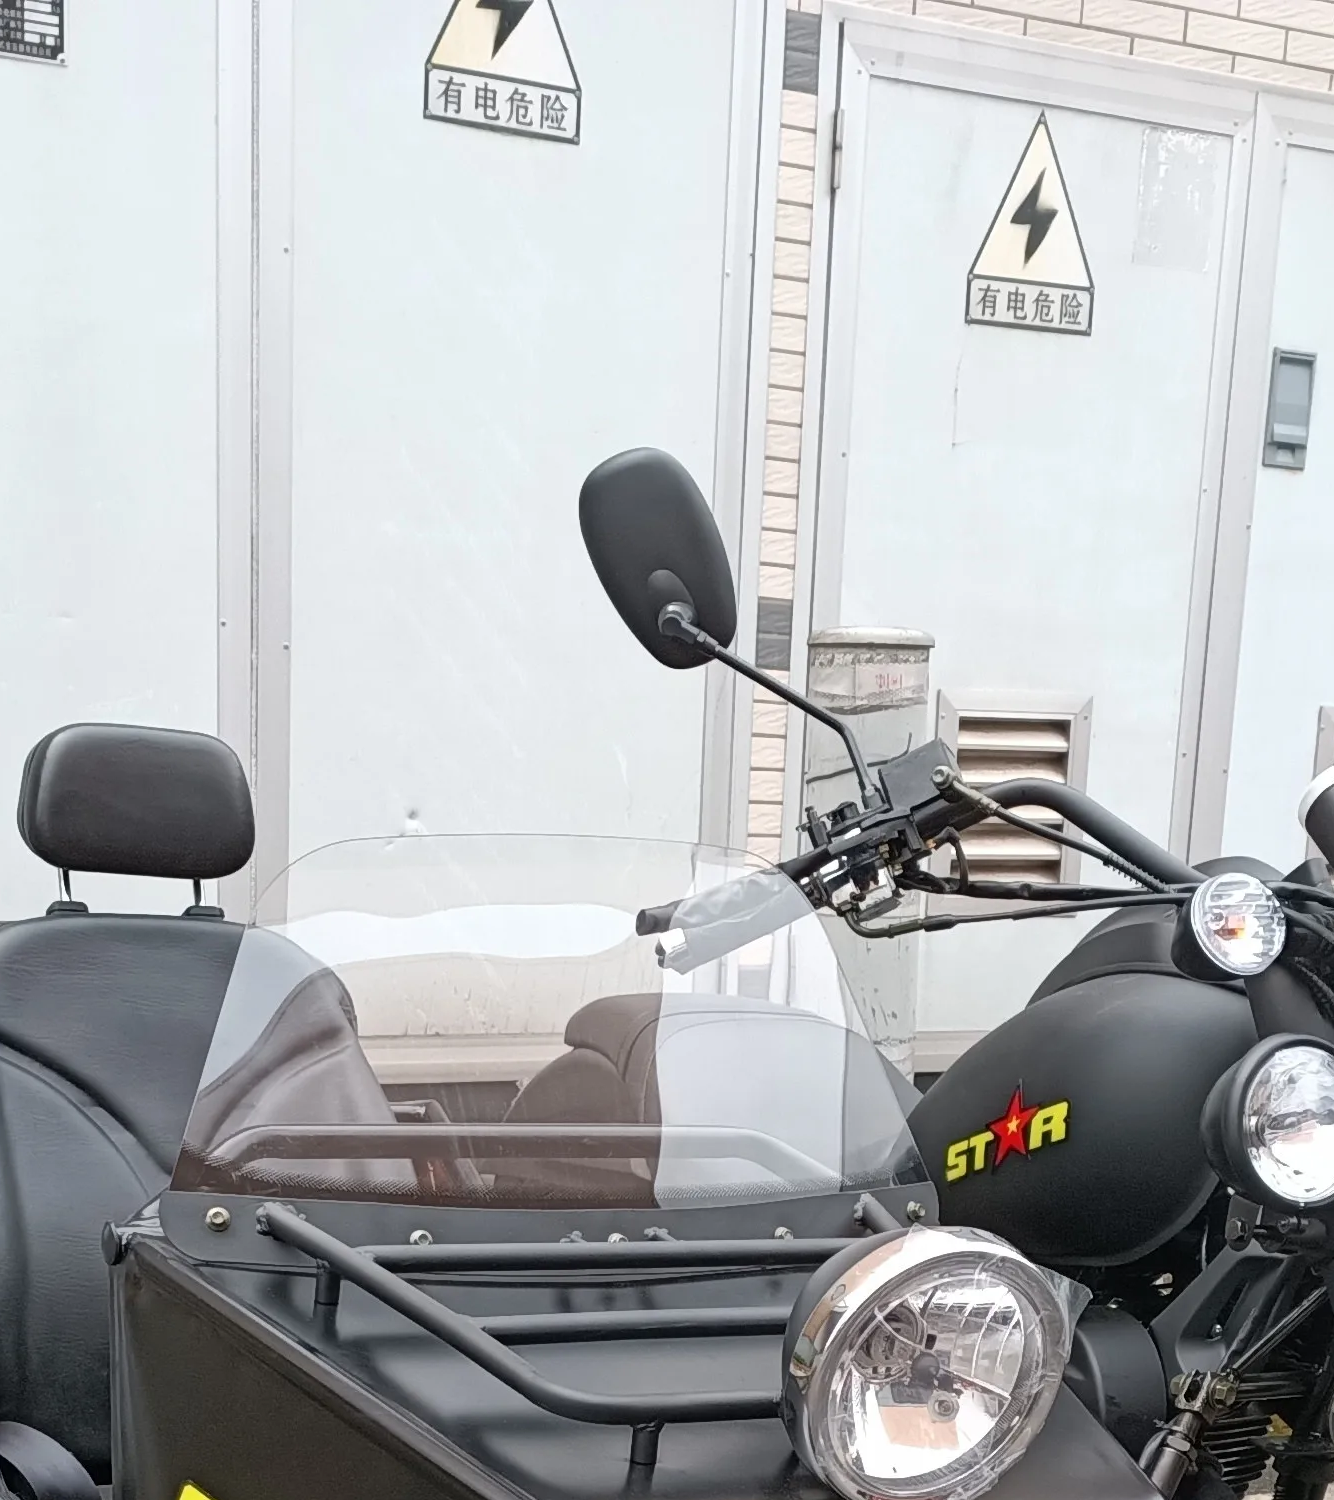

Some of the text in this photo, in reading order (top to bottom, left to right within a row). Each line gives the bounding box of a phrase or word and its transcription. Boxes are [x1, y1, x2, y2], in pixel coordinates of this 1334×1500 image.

[435, 75, 569, 132] 有电危险
[976, 283, 1084, 326] 有电危险
